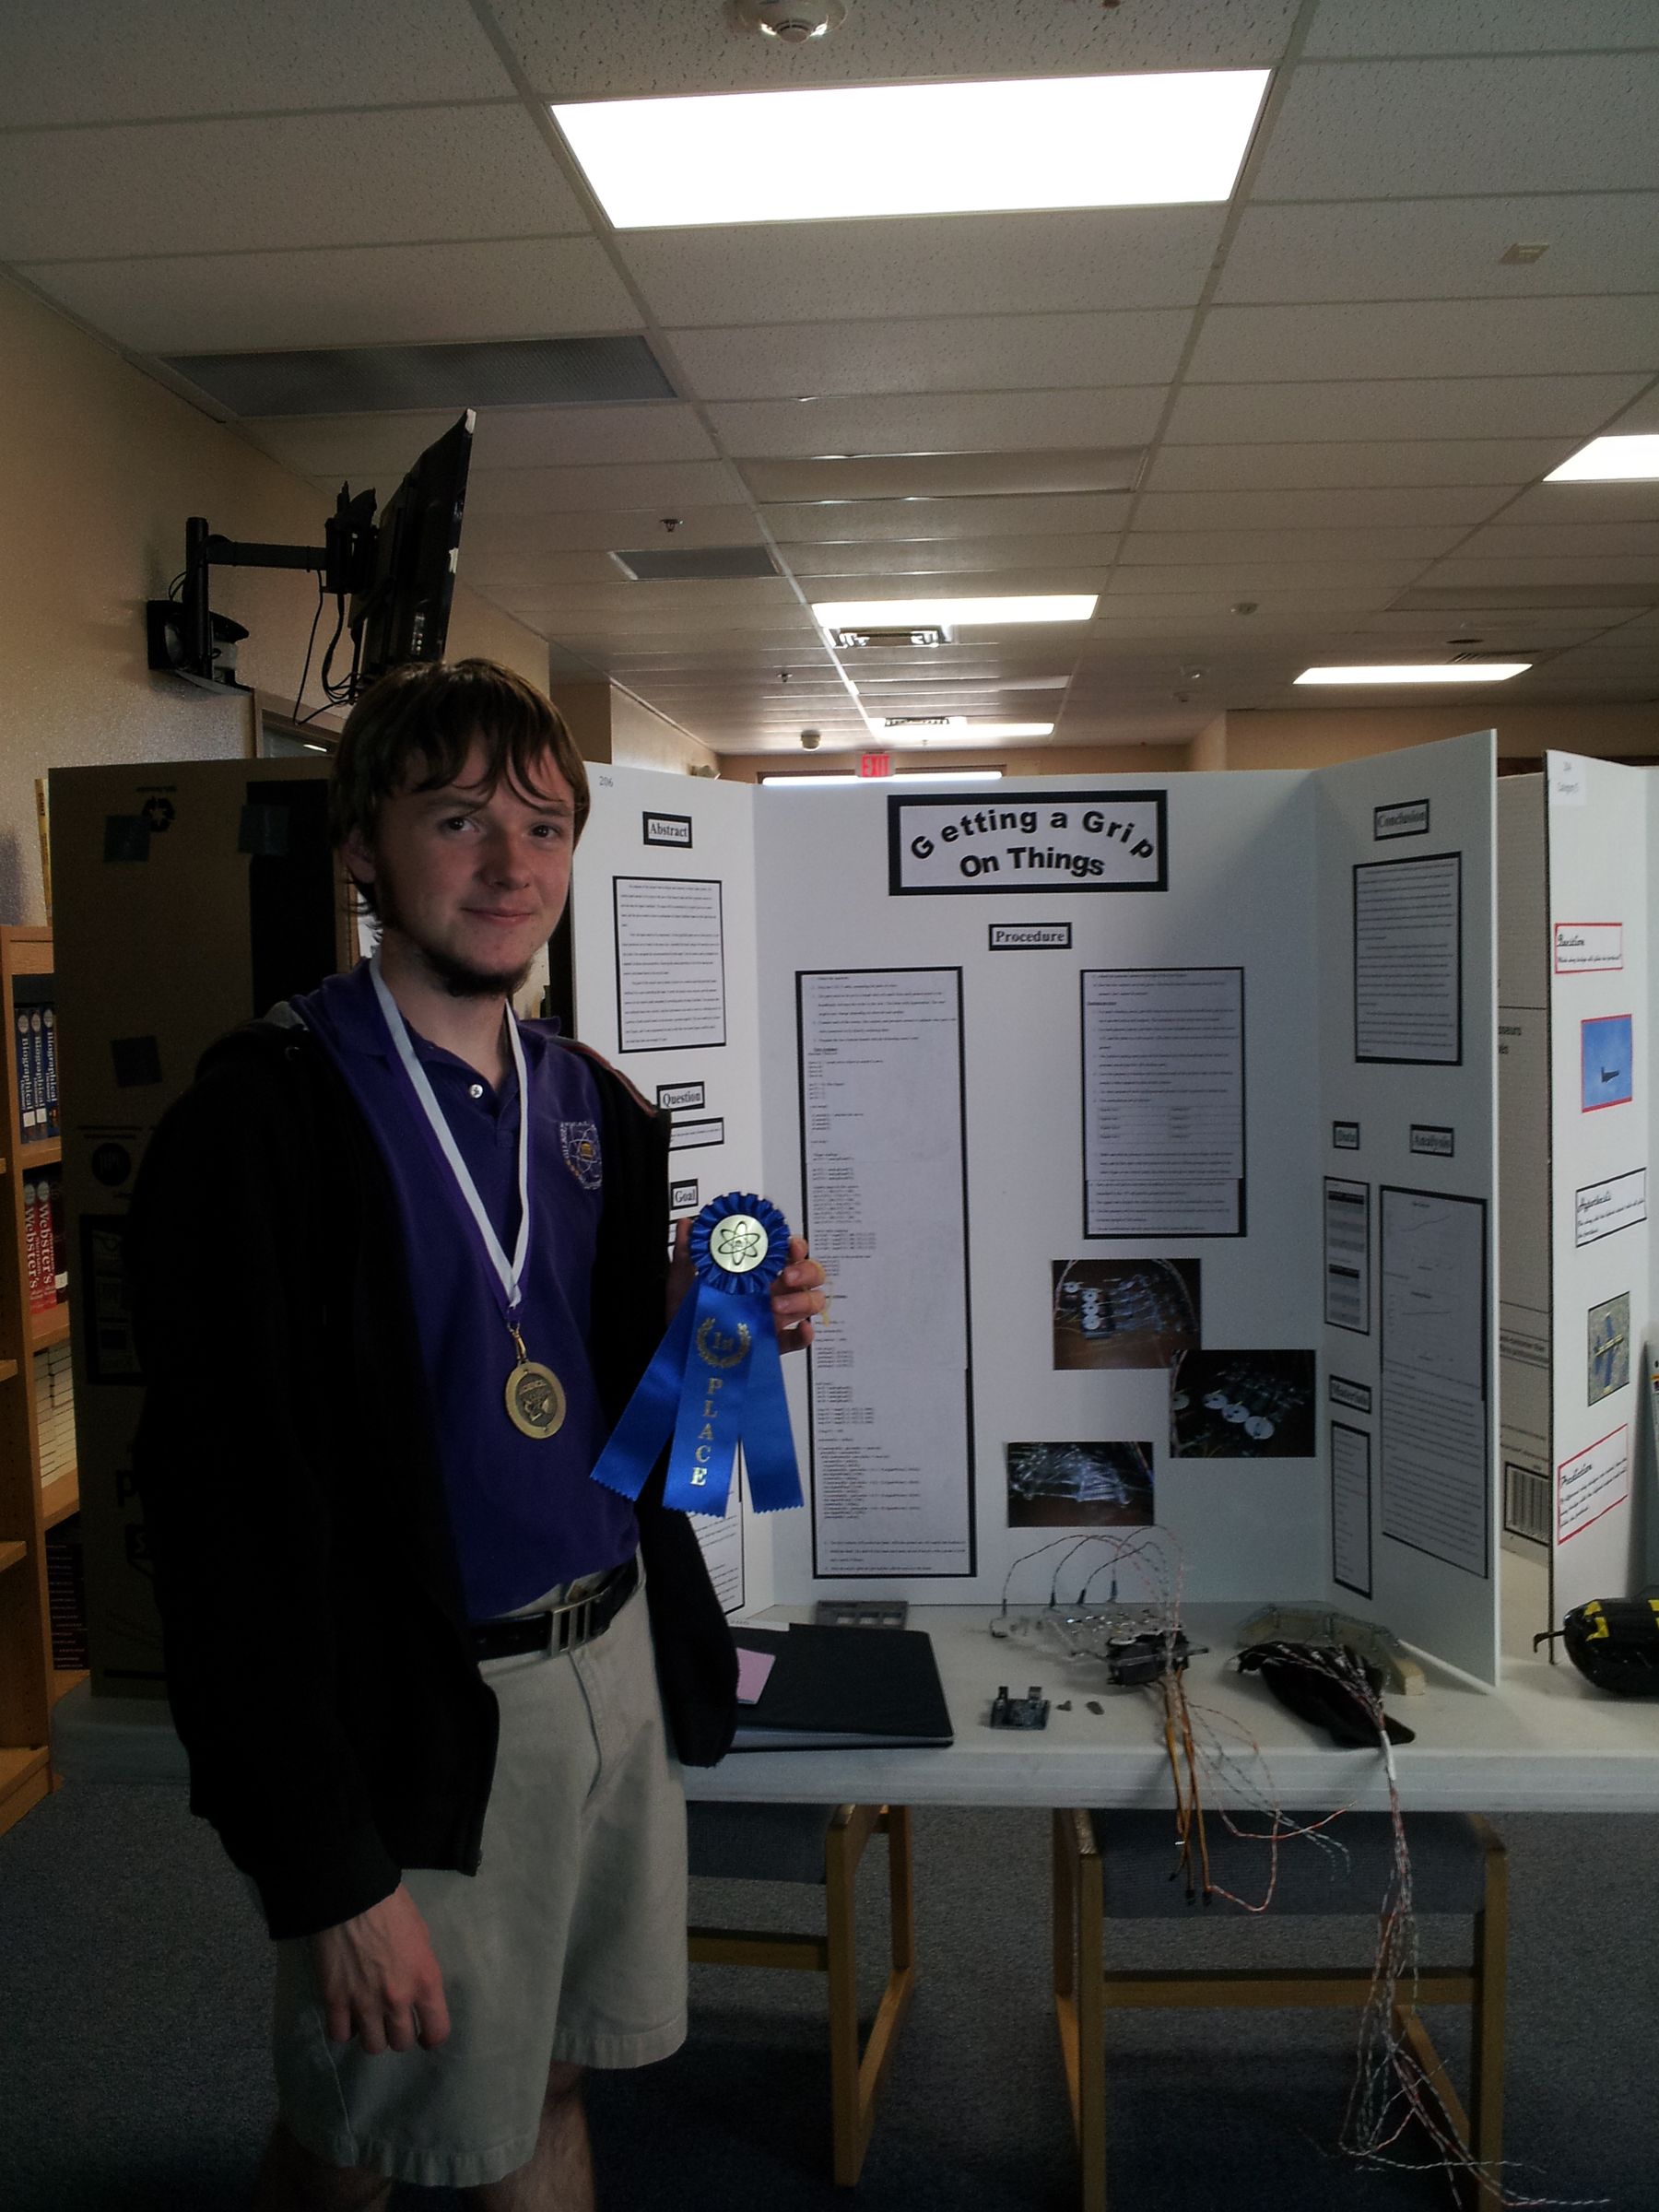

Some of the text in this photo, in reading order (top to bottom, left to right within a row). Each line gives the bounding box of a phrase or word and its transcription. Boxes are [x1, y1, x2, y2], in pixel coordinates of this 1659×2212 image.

[650, 821, 688, 838] Abstract
[911, 809, 1155, 860] Getting a Grip
[959, 847, 1104, 877] On Things
[995, 929, 1065, 944] Procedure
[663, 1090, 701, 1107] Question
[675, 1189, 696, 1204] Goal
[39, 1203, 53, 1285] Webster's
[690, 1378, 723, 1487] PLACE
